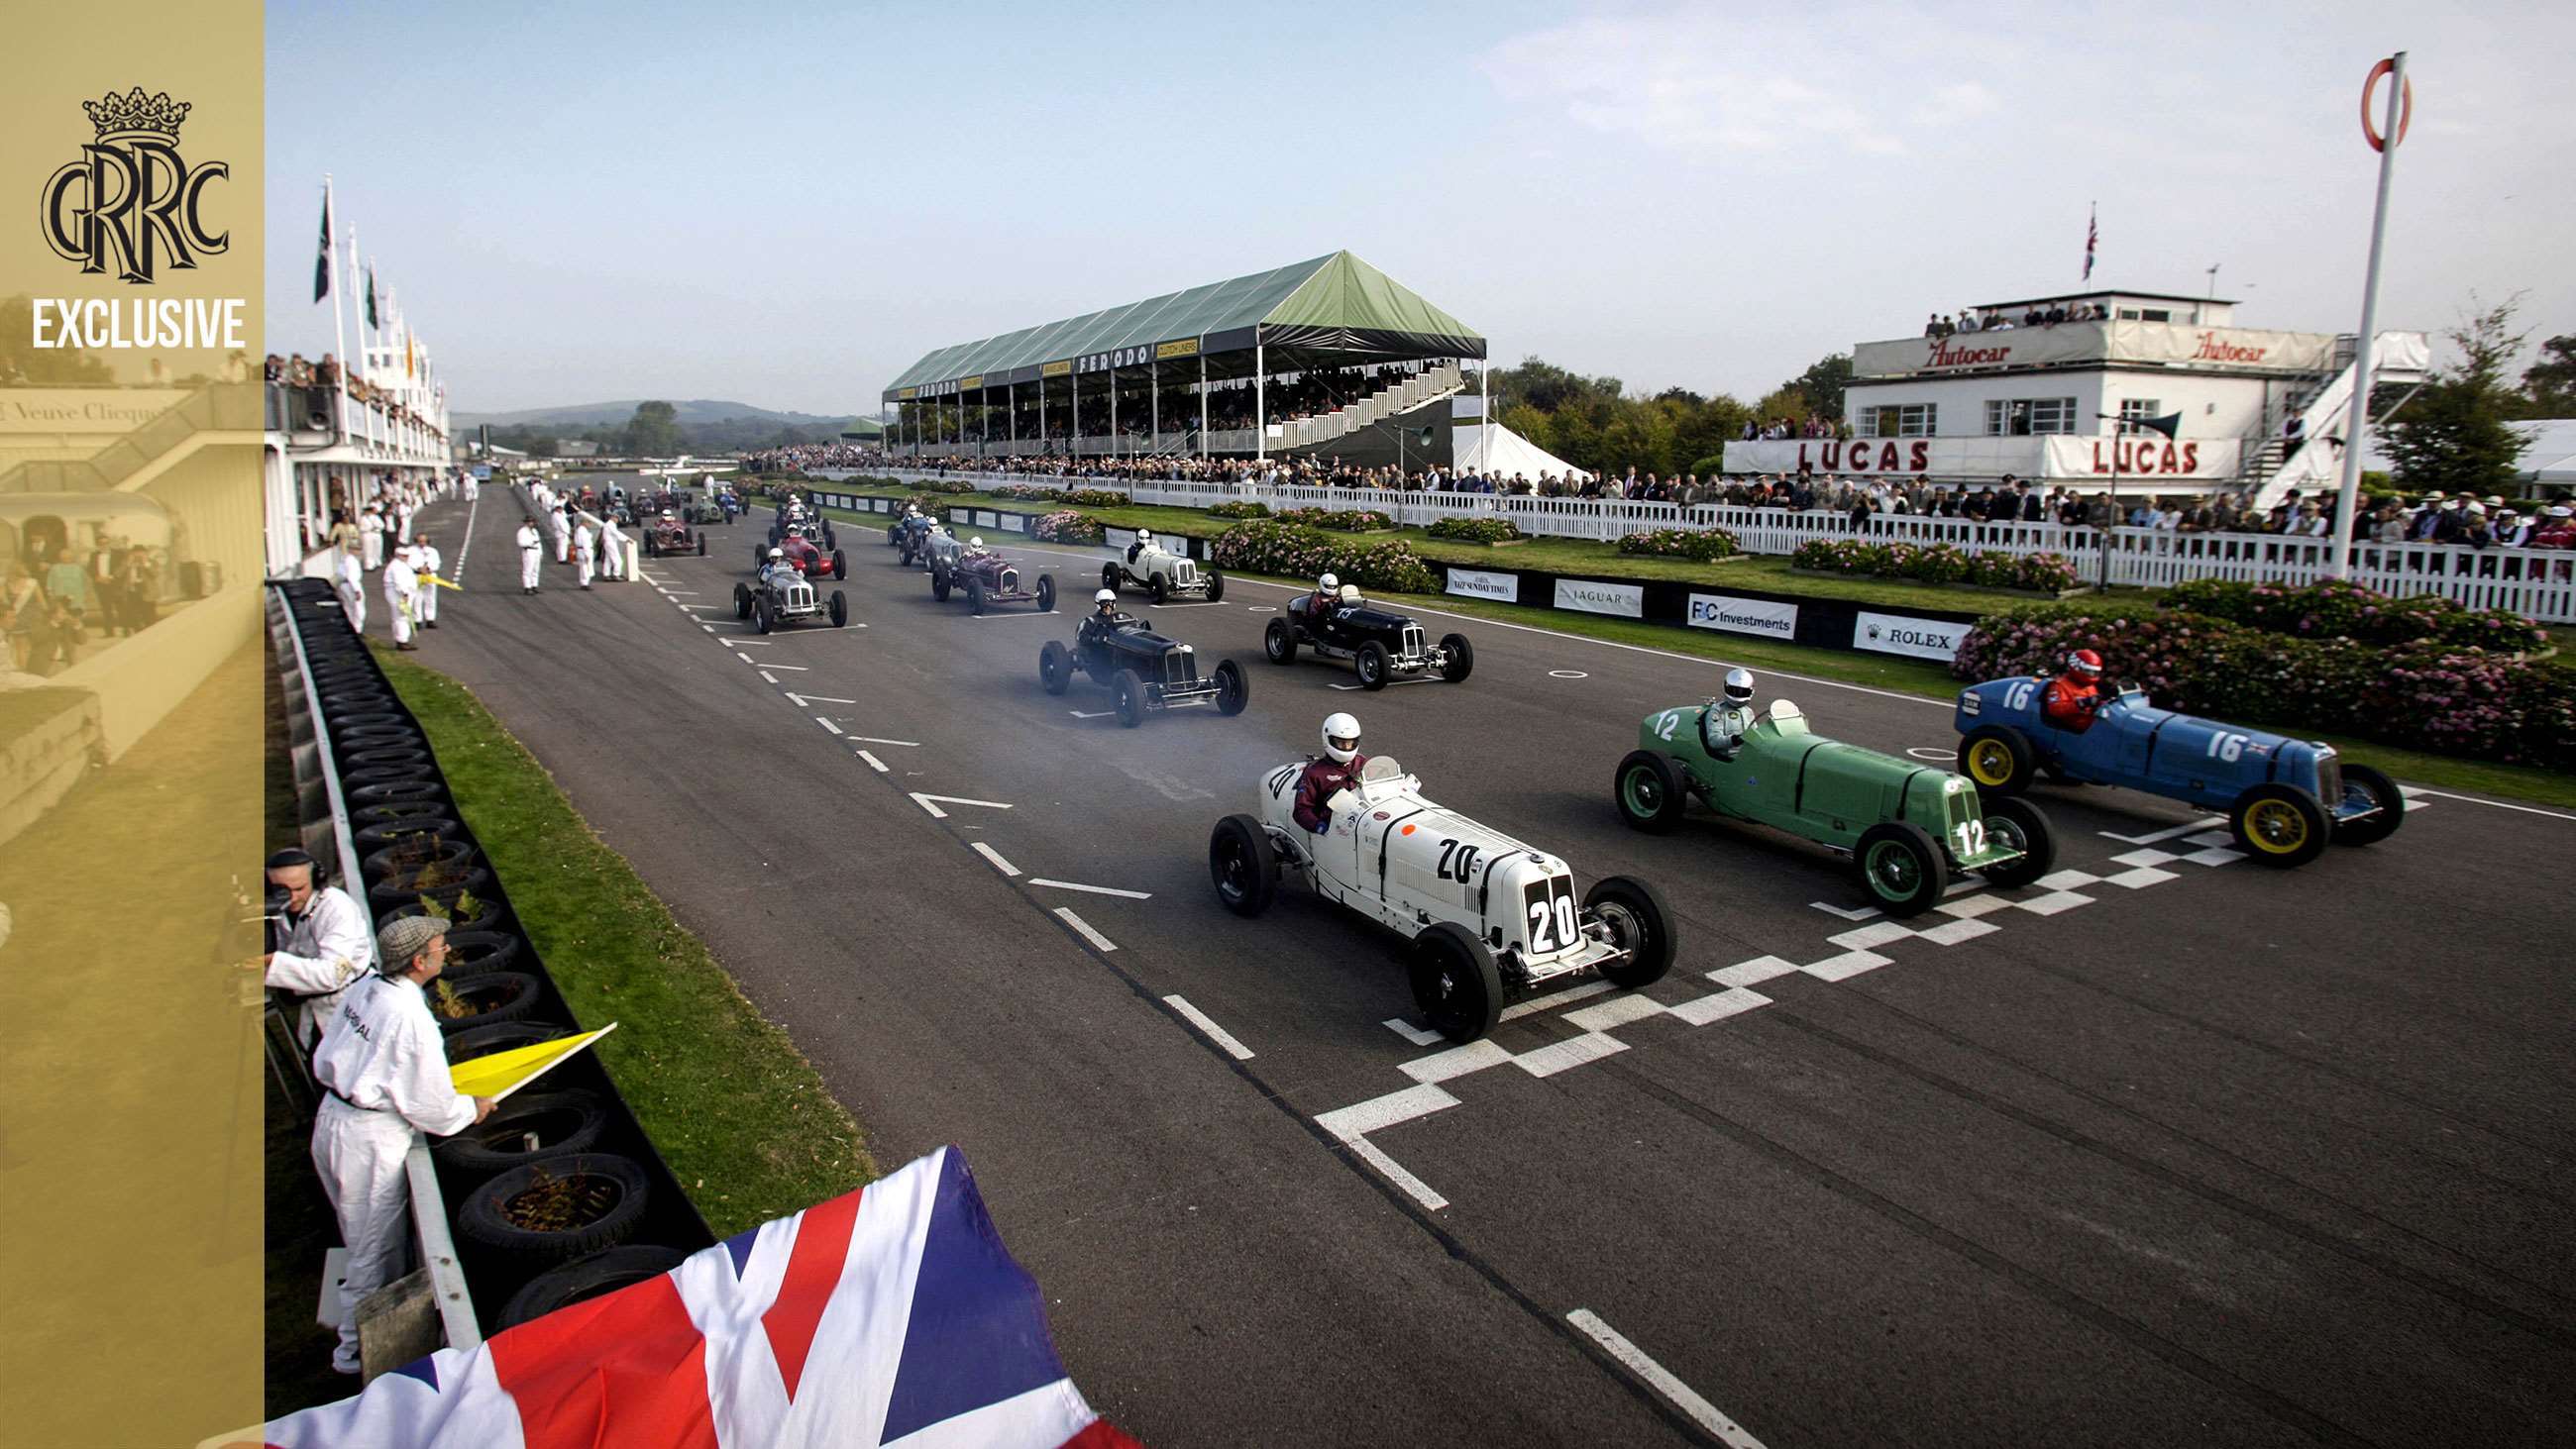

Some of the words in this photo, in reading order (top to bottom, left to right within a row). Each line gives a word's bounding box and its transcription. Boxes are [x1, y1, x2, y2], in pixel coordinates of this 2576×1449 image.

[1079, 346, 1147, 374] FERODO
[1926, 339, 2011, 367] Autocar
[2192, 330, 2267, 362] Autocar
[15, 402, 78, 421] Veuve
[1798, 440, 1928, 472] LUCAS
[2093, 440, 2198, 475] LUCAS
[1466, 581, 1489, 592] SUNDAY
[1489, 584, 1509, 594] TIMES
[1573, 589, 1622, 603] JAGUAR
[1719, 611, 1791, 632] Investments
[1889, 629, 1951, 650] ROLEX
[2003, 681, 2034, 710] 16
[1654, 709, 1679, 742] 12
[2207, 730, 2250, 763] 16
[1957, 819, 1986, 857] 12
[1438, 838, 1480, 884] 20
[1530, 894, 1576, 954] 20
